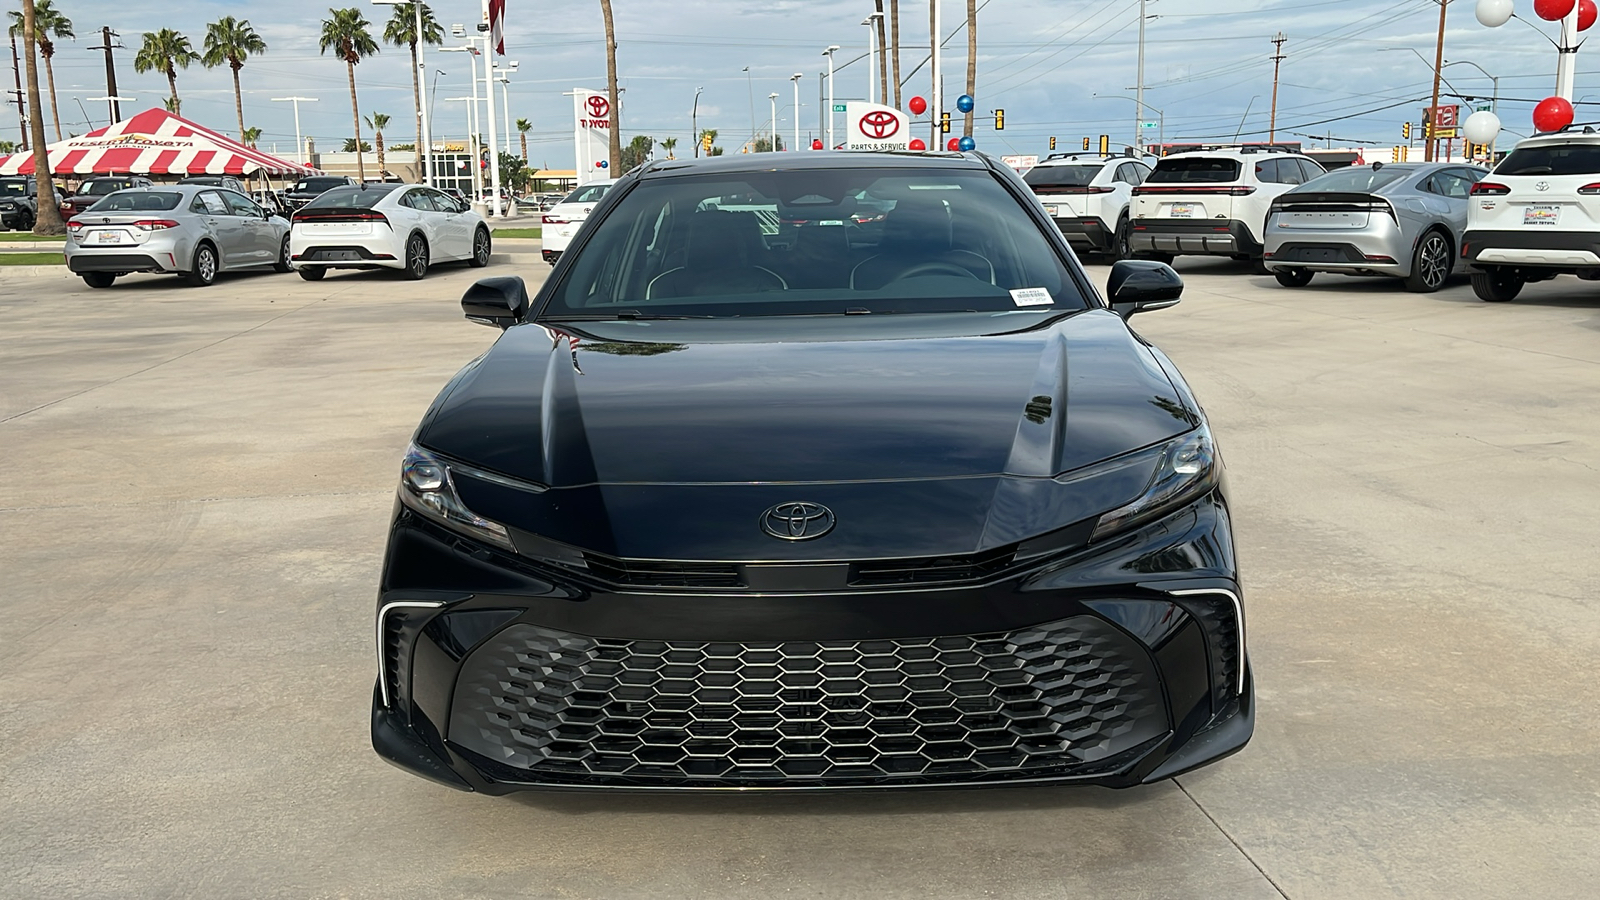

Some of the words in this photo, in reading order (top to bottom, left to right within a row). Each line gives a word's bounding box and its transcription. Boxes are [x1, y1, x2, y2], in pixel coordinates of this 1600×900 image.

[580, 119, 610, 128] TOYOT
[68, 139, 124, 147] DESERT
[133, 138, 194, 147] TOYOTA
